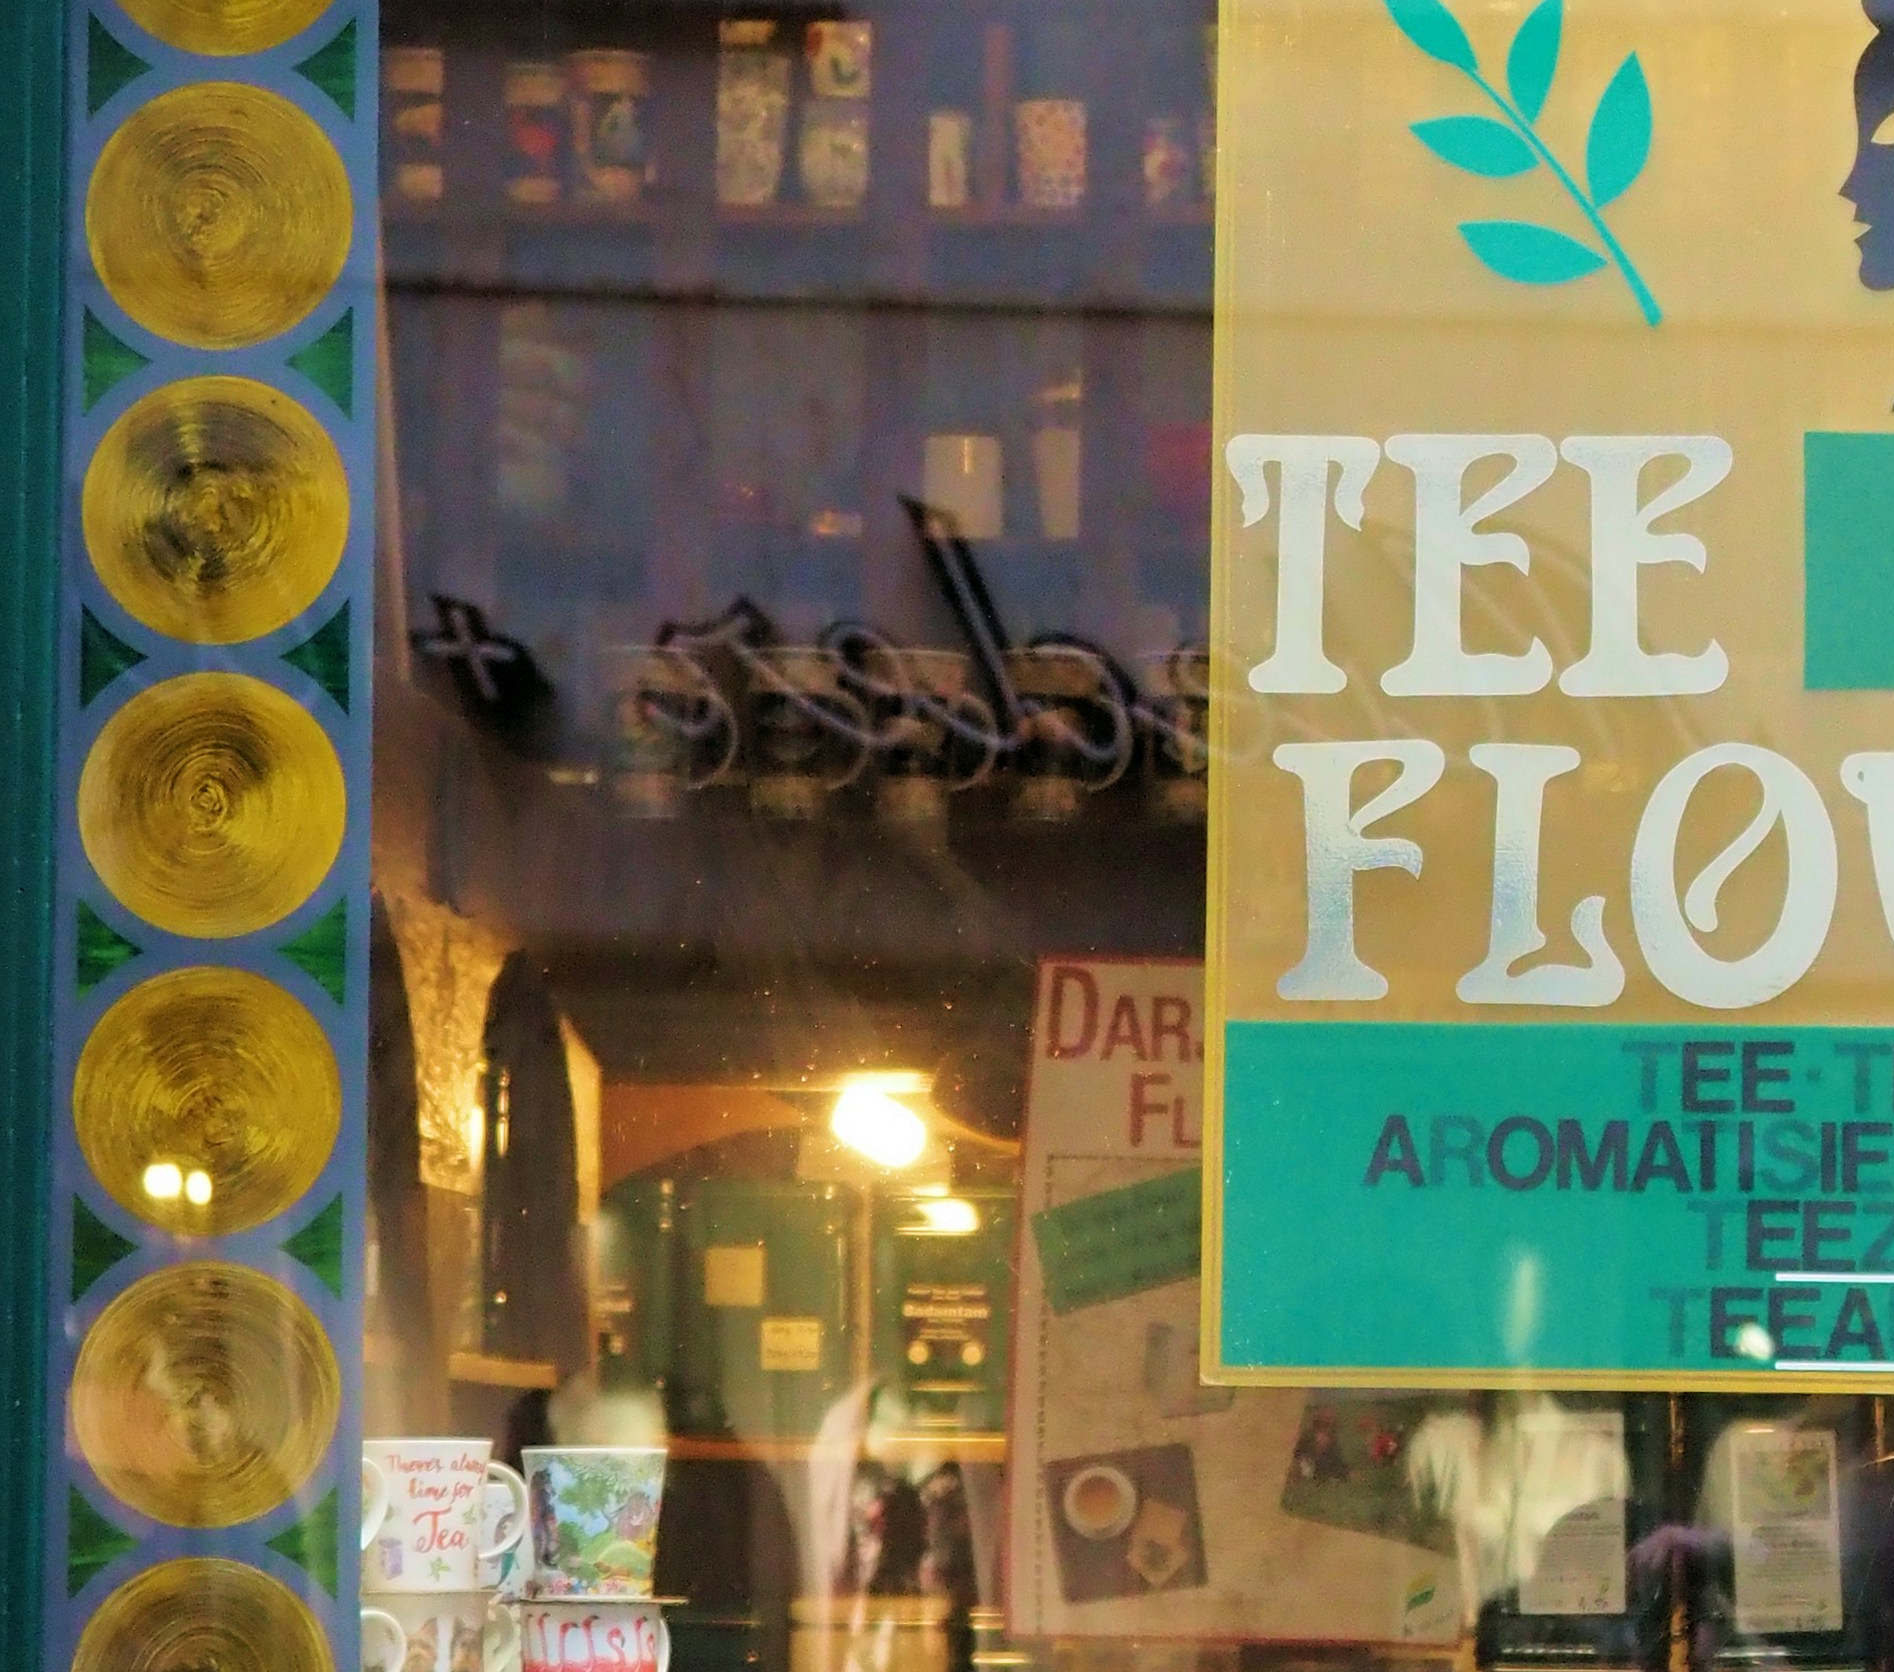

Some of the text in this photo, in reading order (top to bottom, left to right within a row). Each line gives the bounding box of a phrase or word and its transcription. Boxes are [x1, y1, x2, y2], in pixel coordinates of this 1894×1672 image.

[1226, 433, 1735, 697] TEE
[1621, 1040, 1795, 1114] TEE
[408, 1477, 475, 1505] time for
[412, 1506, 469, 1555] Tea
